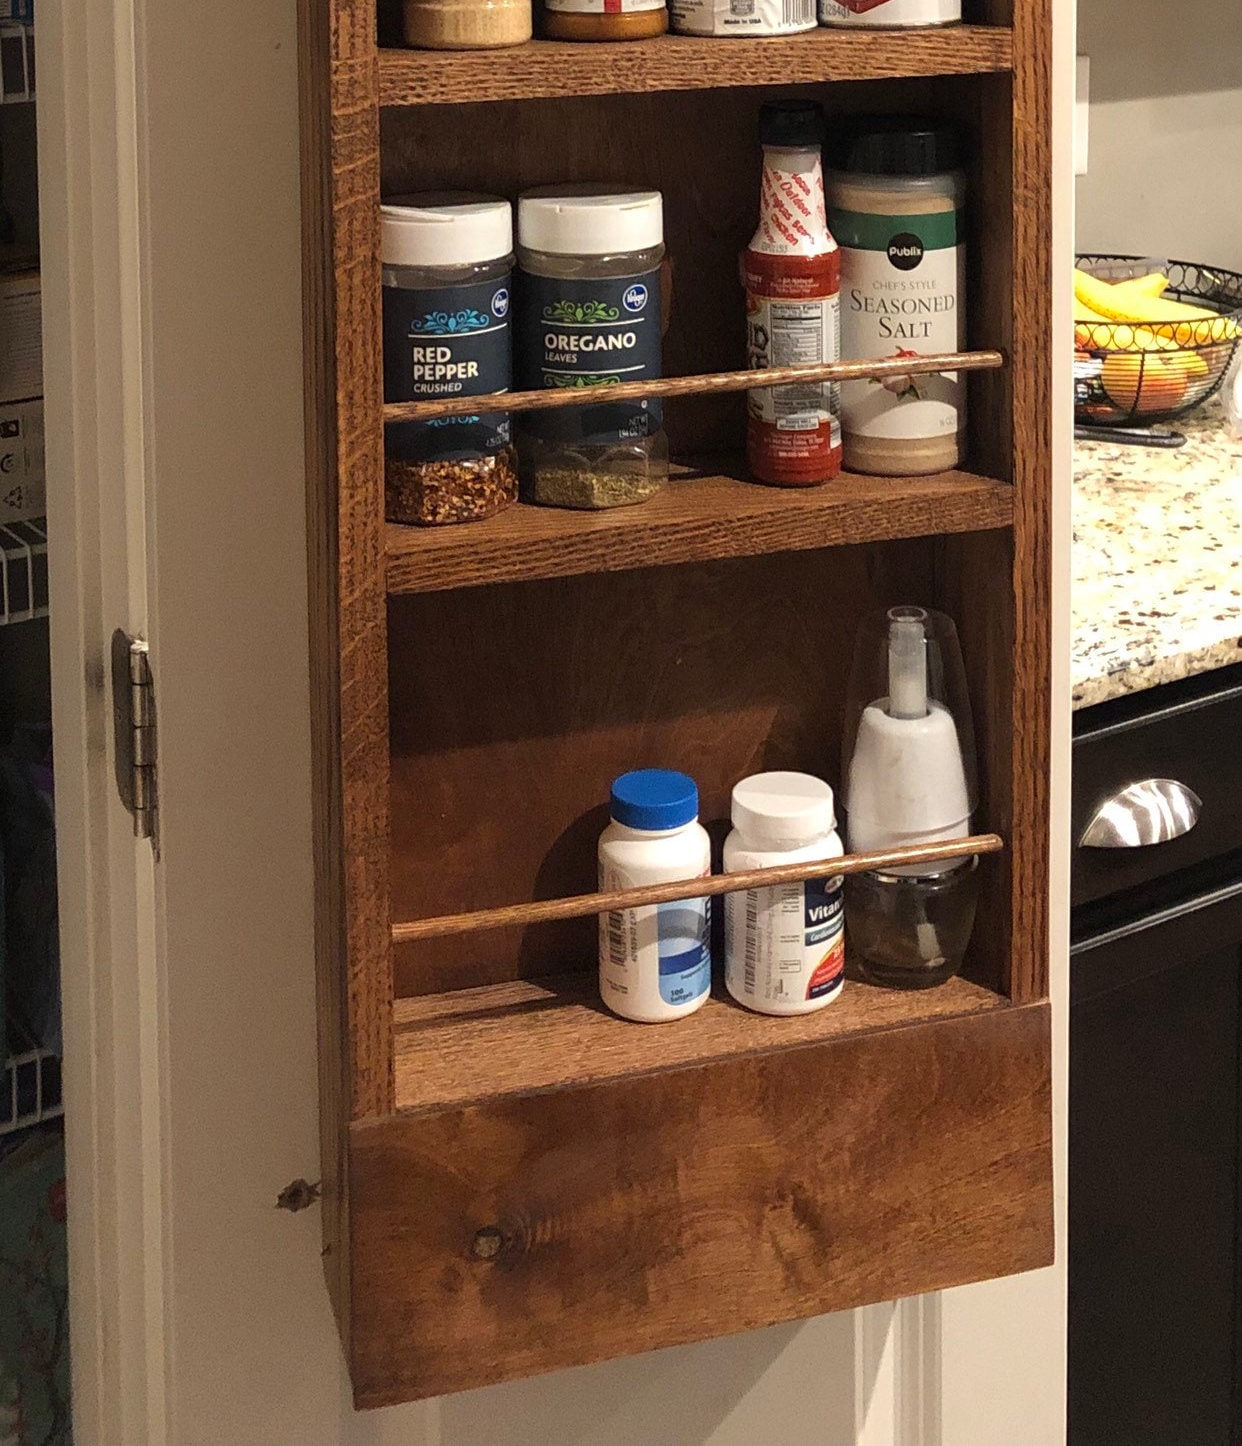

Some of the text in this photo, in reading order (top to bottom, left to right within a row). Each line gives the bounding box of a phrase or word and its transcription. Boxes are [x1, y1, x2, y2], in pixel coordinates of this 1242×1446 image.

[889, 246, 922, 257] Publix
[872, 280, 937, 291] CHEF'S STYLE
[850, 289, 956, 315] SEASONED
[878, 315, 933, 339] SALT
[544, 332, 637, 352] OREGANO
[413, 346, 452, 363] RED
[545, 351, 578, 364] LEAVES
[413, 361, 479, 381] PEPPER
[413, 382, 463, 394] CRUSHED
[670, 987, 684, 997] 100
